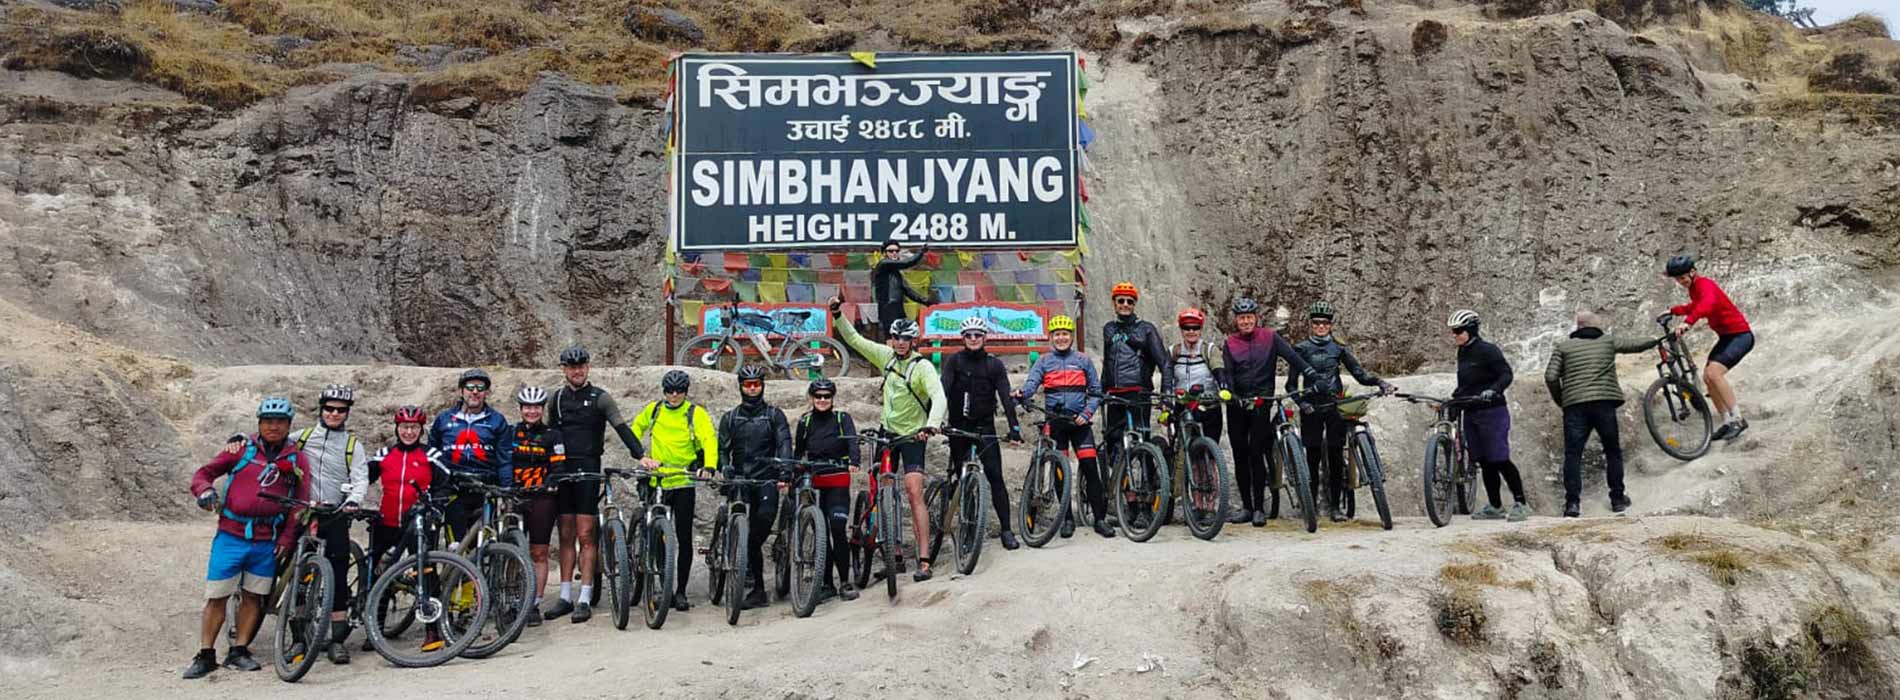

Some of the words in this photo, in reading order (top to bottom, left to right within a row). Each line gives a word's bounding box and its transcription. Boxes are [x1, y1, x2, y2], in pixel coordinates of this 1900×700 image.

[786, 114, 852, 143] उचाई
[858, 119, 925, 140] २४८८
[934, 112, 972, 139] मी.
[691, 156, 1064, 206] SIMBHANJYANG
[748, 213, 879, 242] HEIGHT
[889, 212, 969, 241] 2488
[980, 212, 1016, 240] M.
